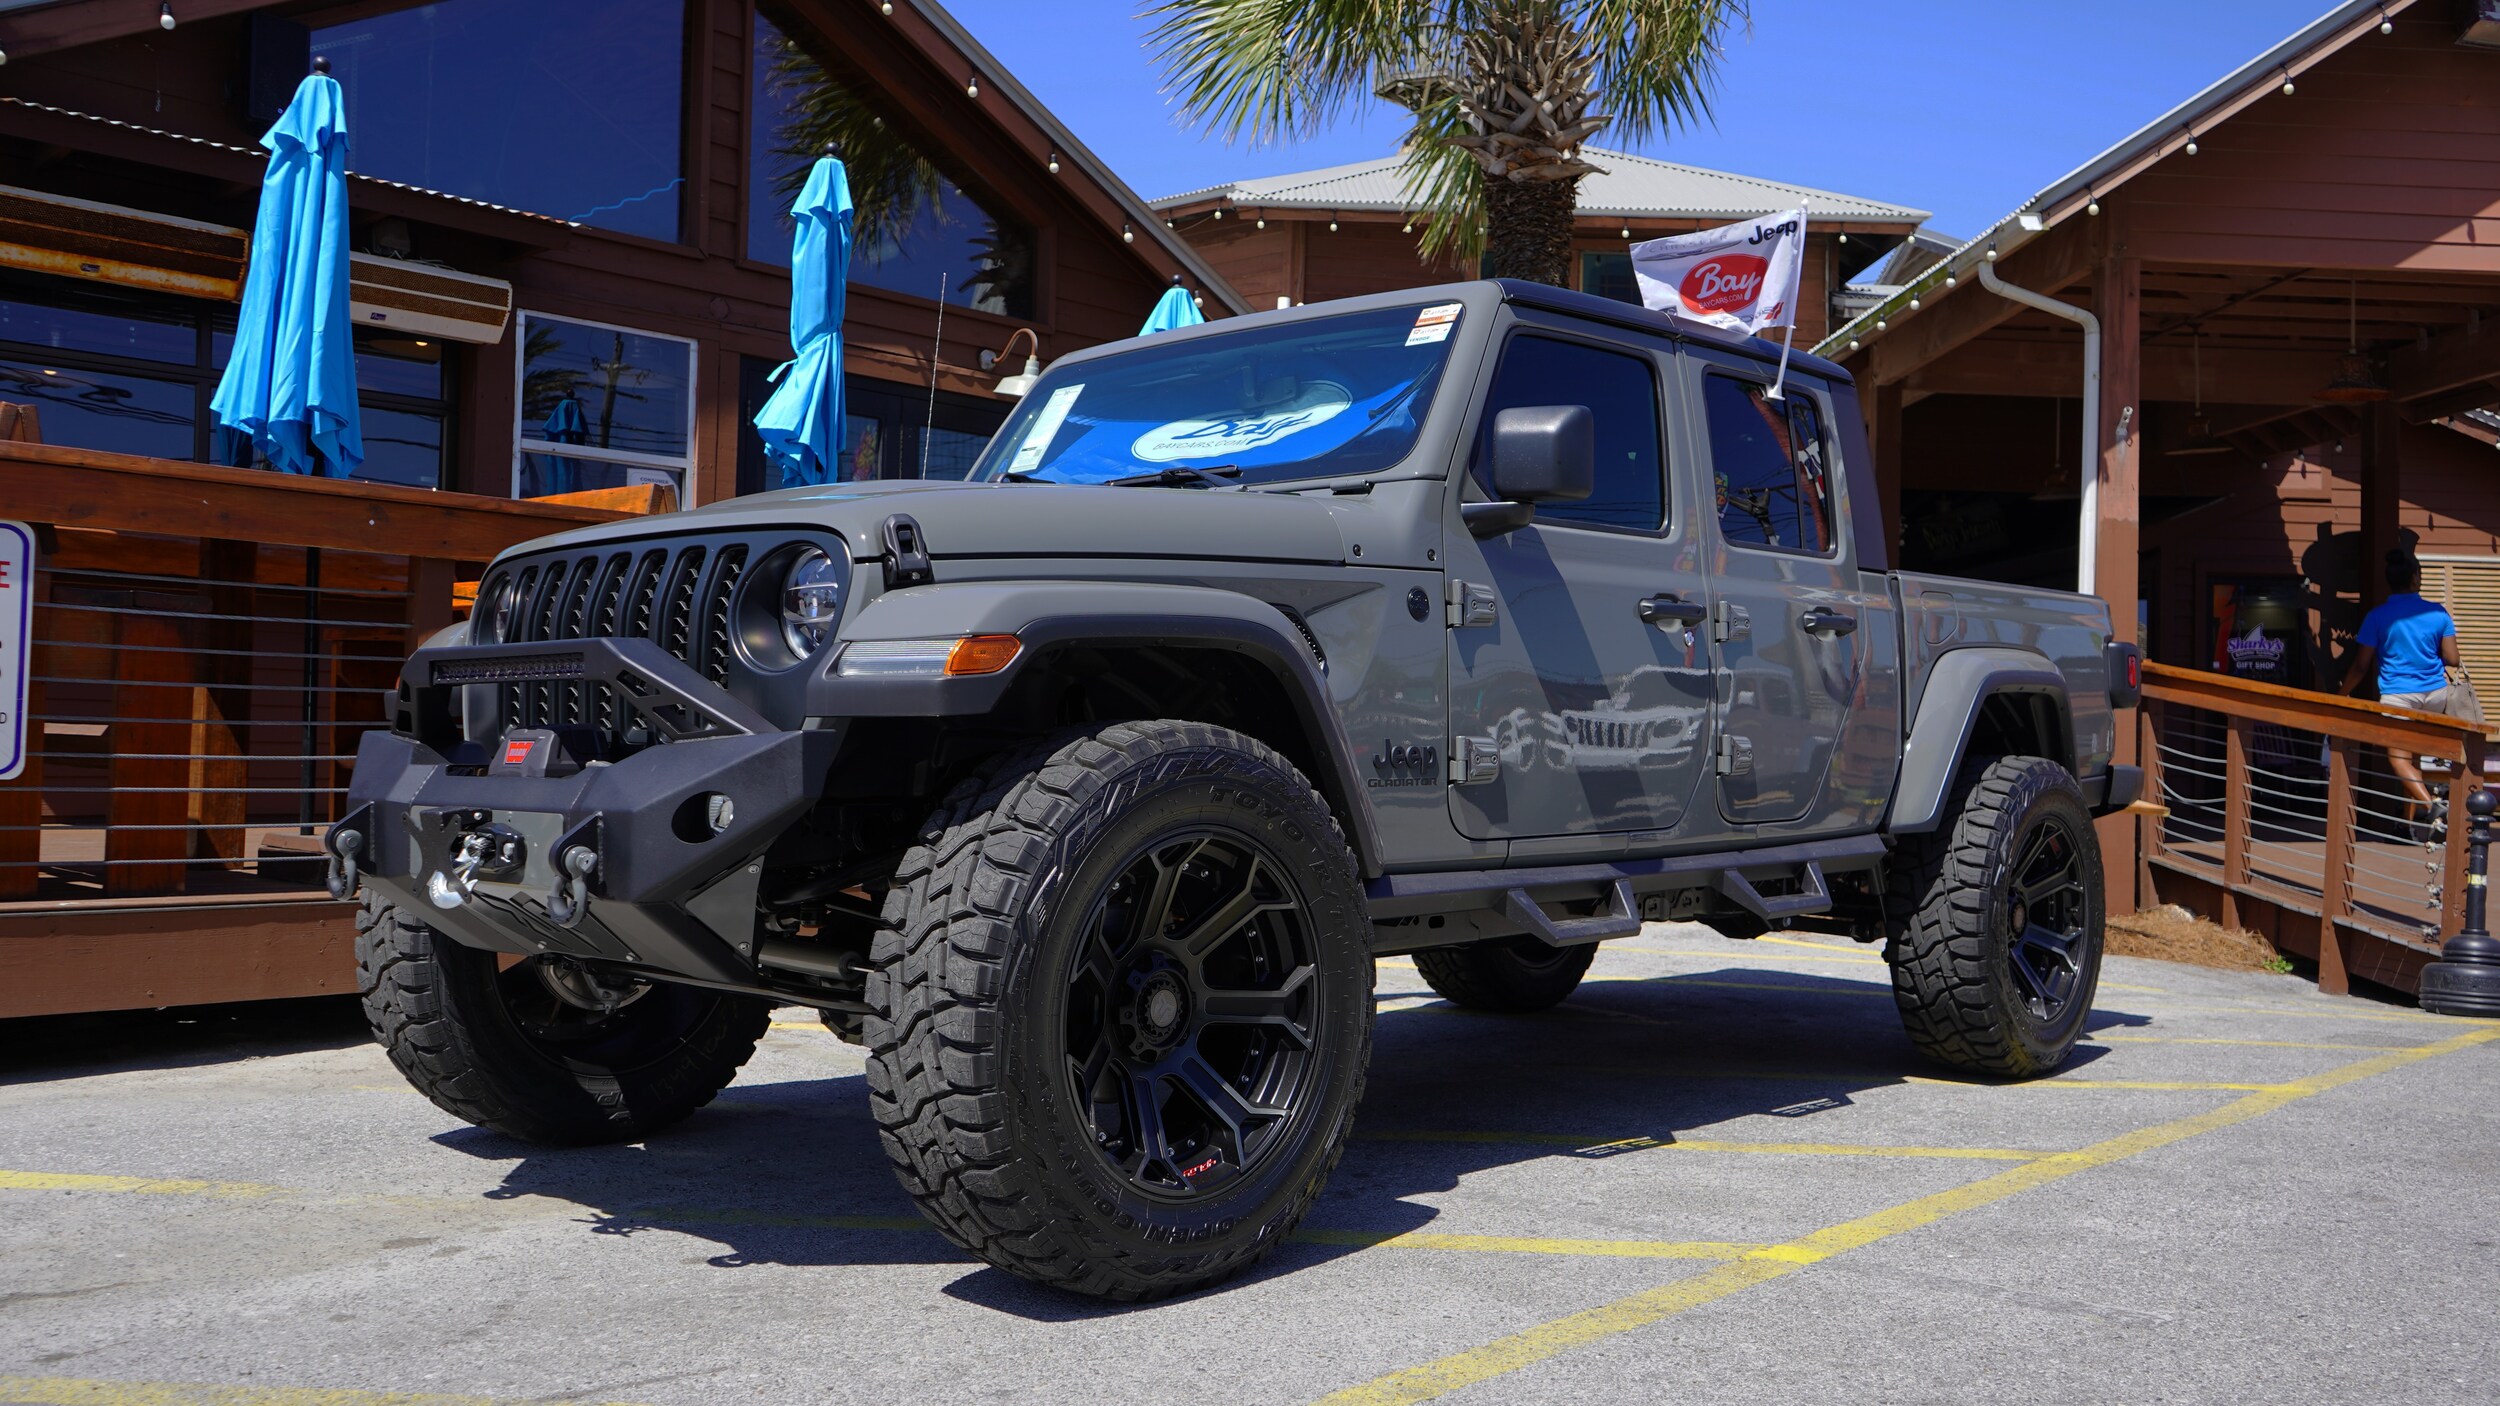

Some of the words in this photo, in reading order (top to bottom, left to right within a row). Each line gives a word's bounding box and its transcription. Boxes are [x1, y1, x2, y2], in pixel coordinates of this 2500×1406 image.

[1748, 220, 1798, 246] Jeep
[1694, 263, 1761, 300] Bay
[2228, 637, 2282, 651] Sharky's
[2236, 661, 2253, 669] GIFT
[2255, 661, 2276, 670] SHOP
[1373, 738, 1438, 774] Jeep
[1367, 777, 1438, 788] GLADIATOR
[1209, 784, 1306, 844] TOYO
